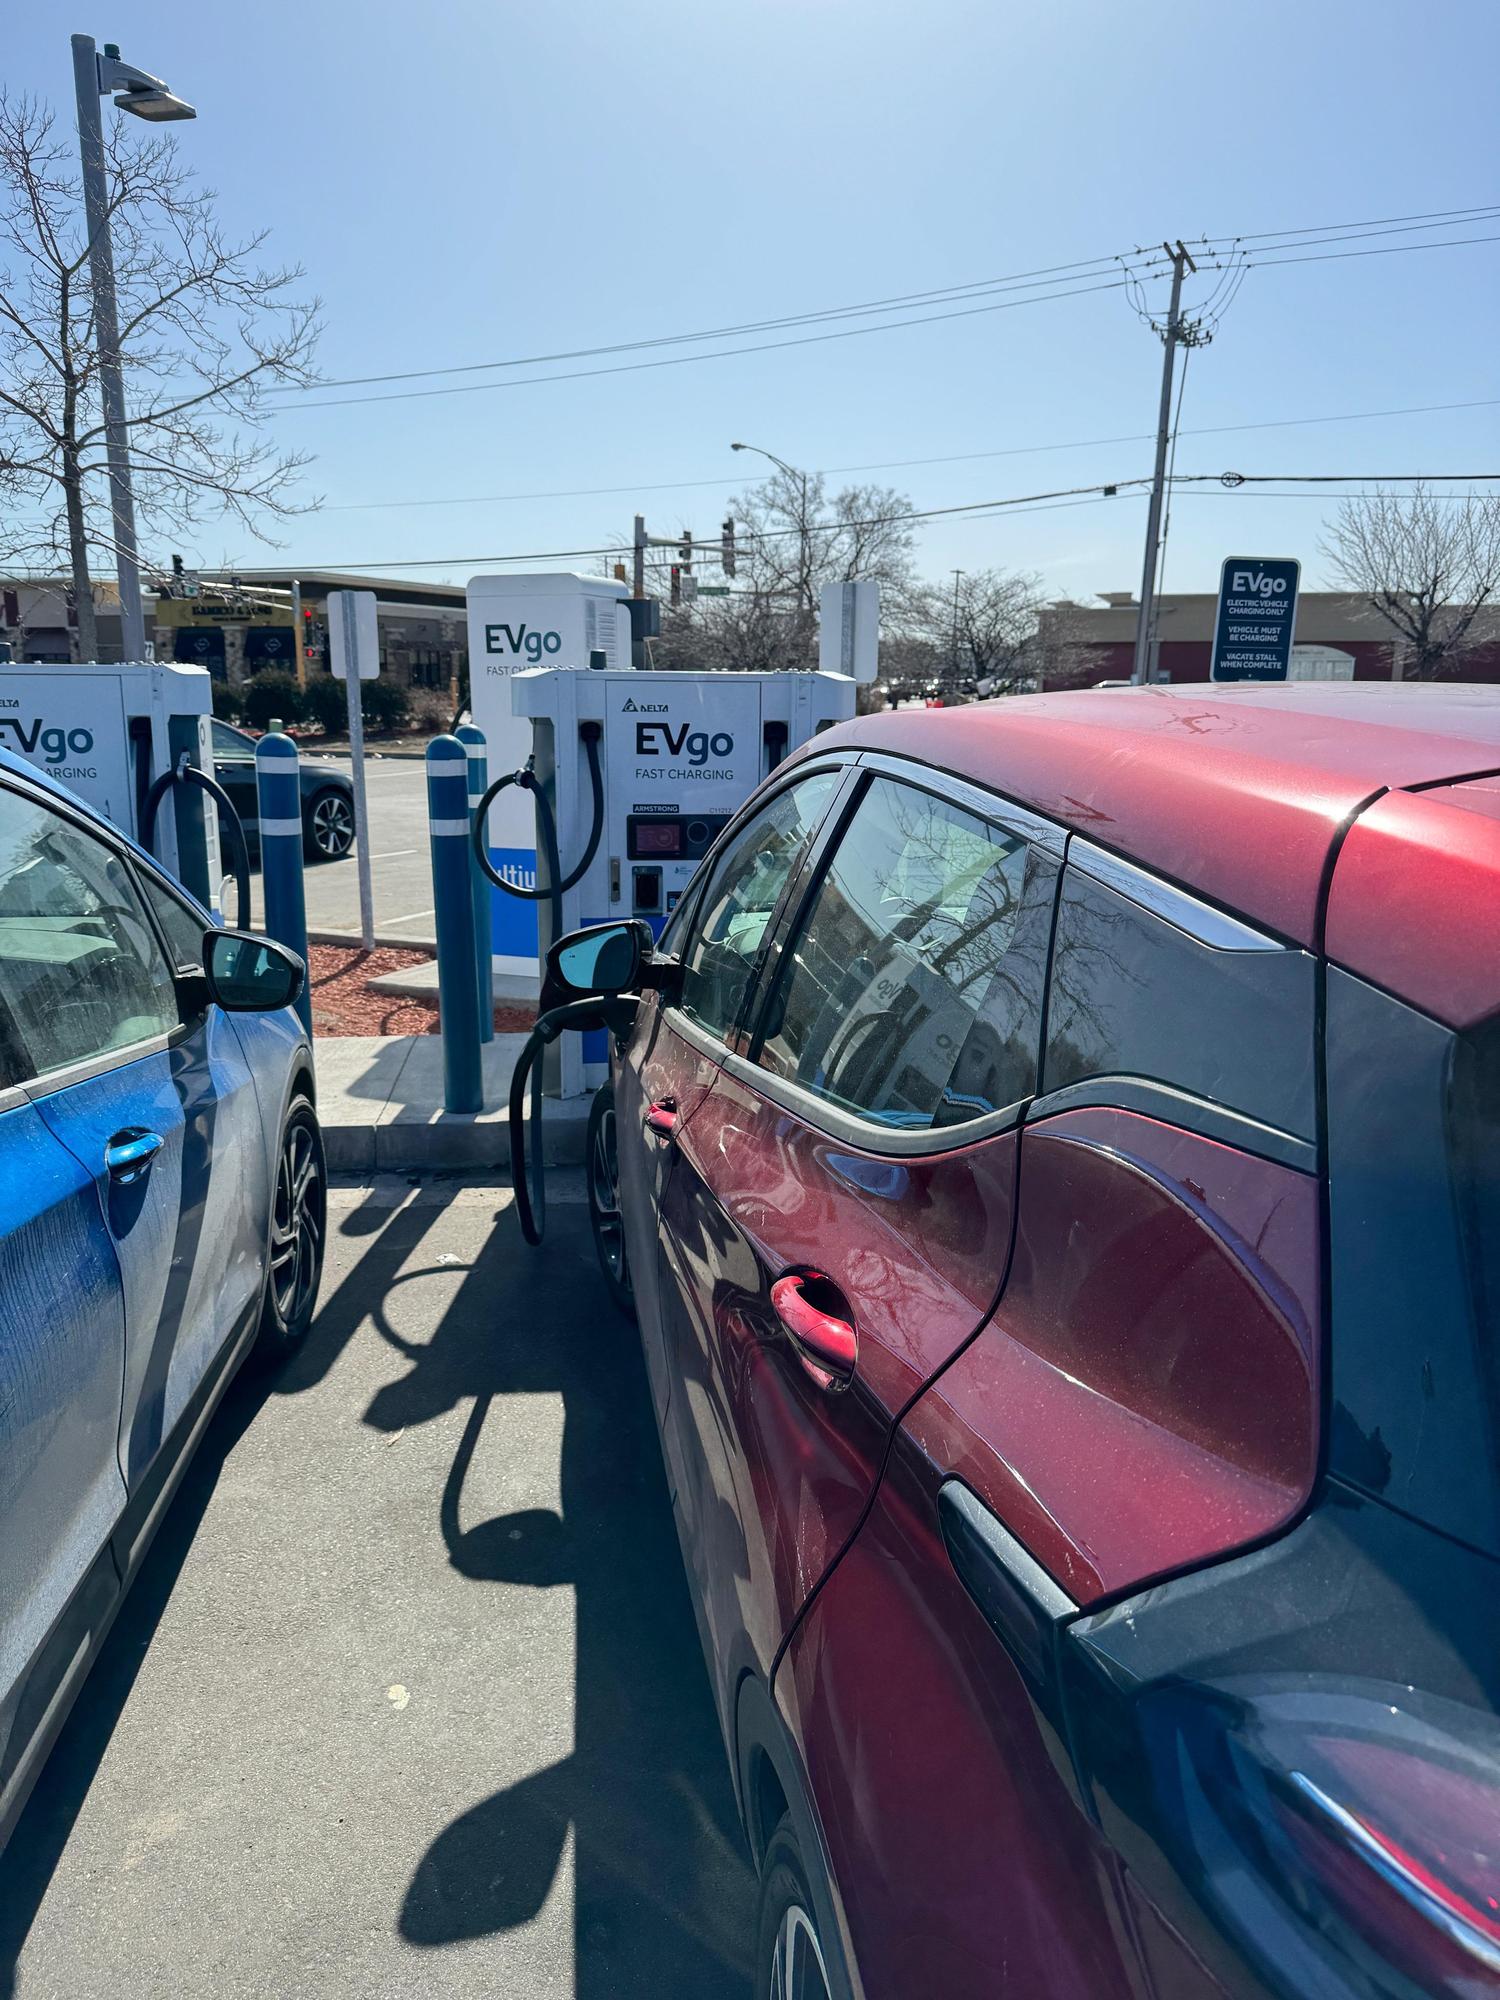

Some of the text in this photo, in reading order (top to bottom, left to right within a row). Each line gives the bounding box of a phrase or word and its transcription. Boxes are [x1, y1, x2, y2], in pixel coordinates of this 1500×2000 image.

[1232, 571, 1287, 598] EVgo
[1226, 599, 1289, 608] ELECTRIC VEHICLE
[1228, 607, 1265, 615] CHARGING
[1228, 626, 1259, 634] VEHICLE
[485, 623, 562, 663] EVgo
[1240, 634, 1279, 642] CHARGING
[1255, 653, 1278, 661] STALL
[1220, 660, 1282, 669] WHEN COMPLETE
[486, 665, 509, 676] FAST
[640, 704, 669, 713] DELTA
[636, 722, 734, 766] EVgo
[40, 767, 97, 779] ARGING
[635, 768, 735, 780] FAST CHARGING
[497, 864, 536, 889] ltiu
